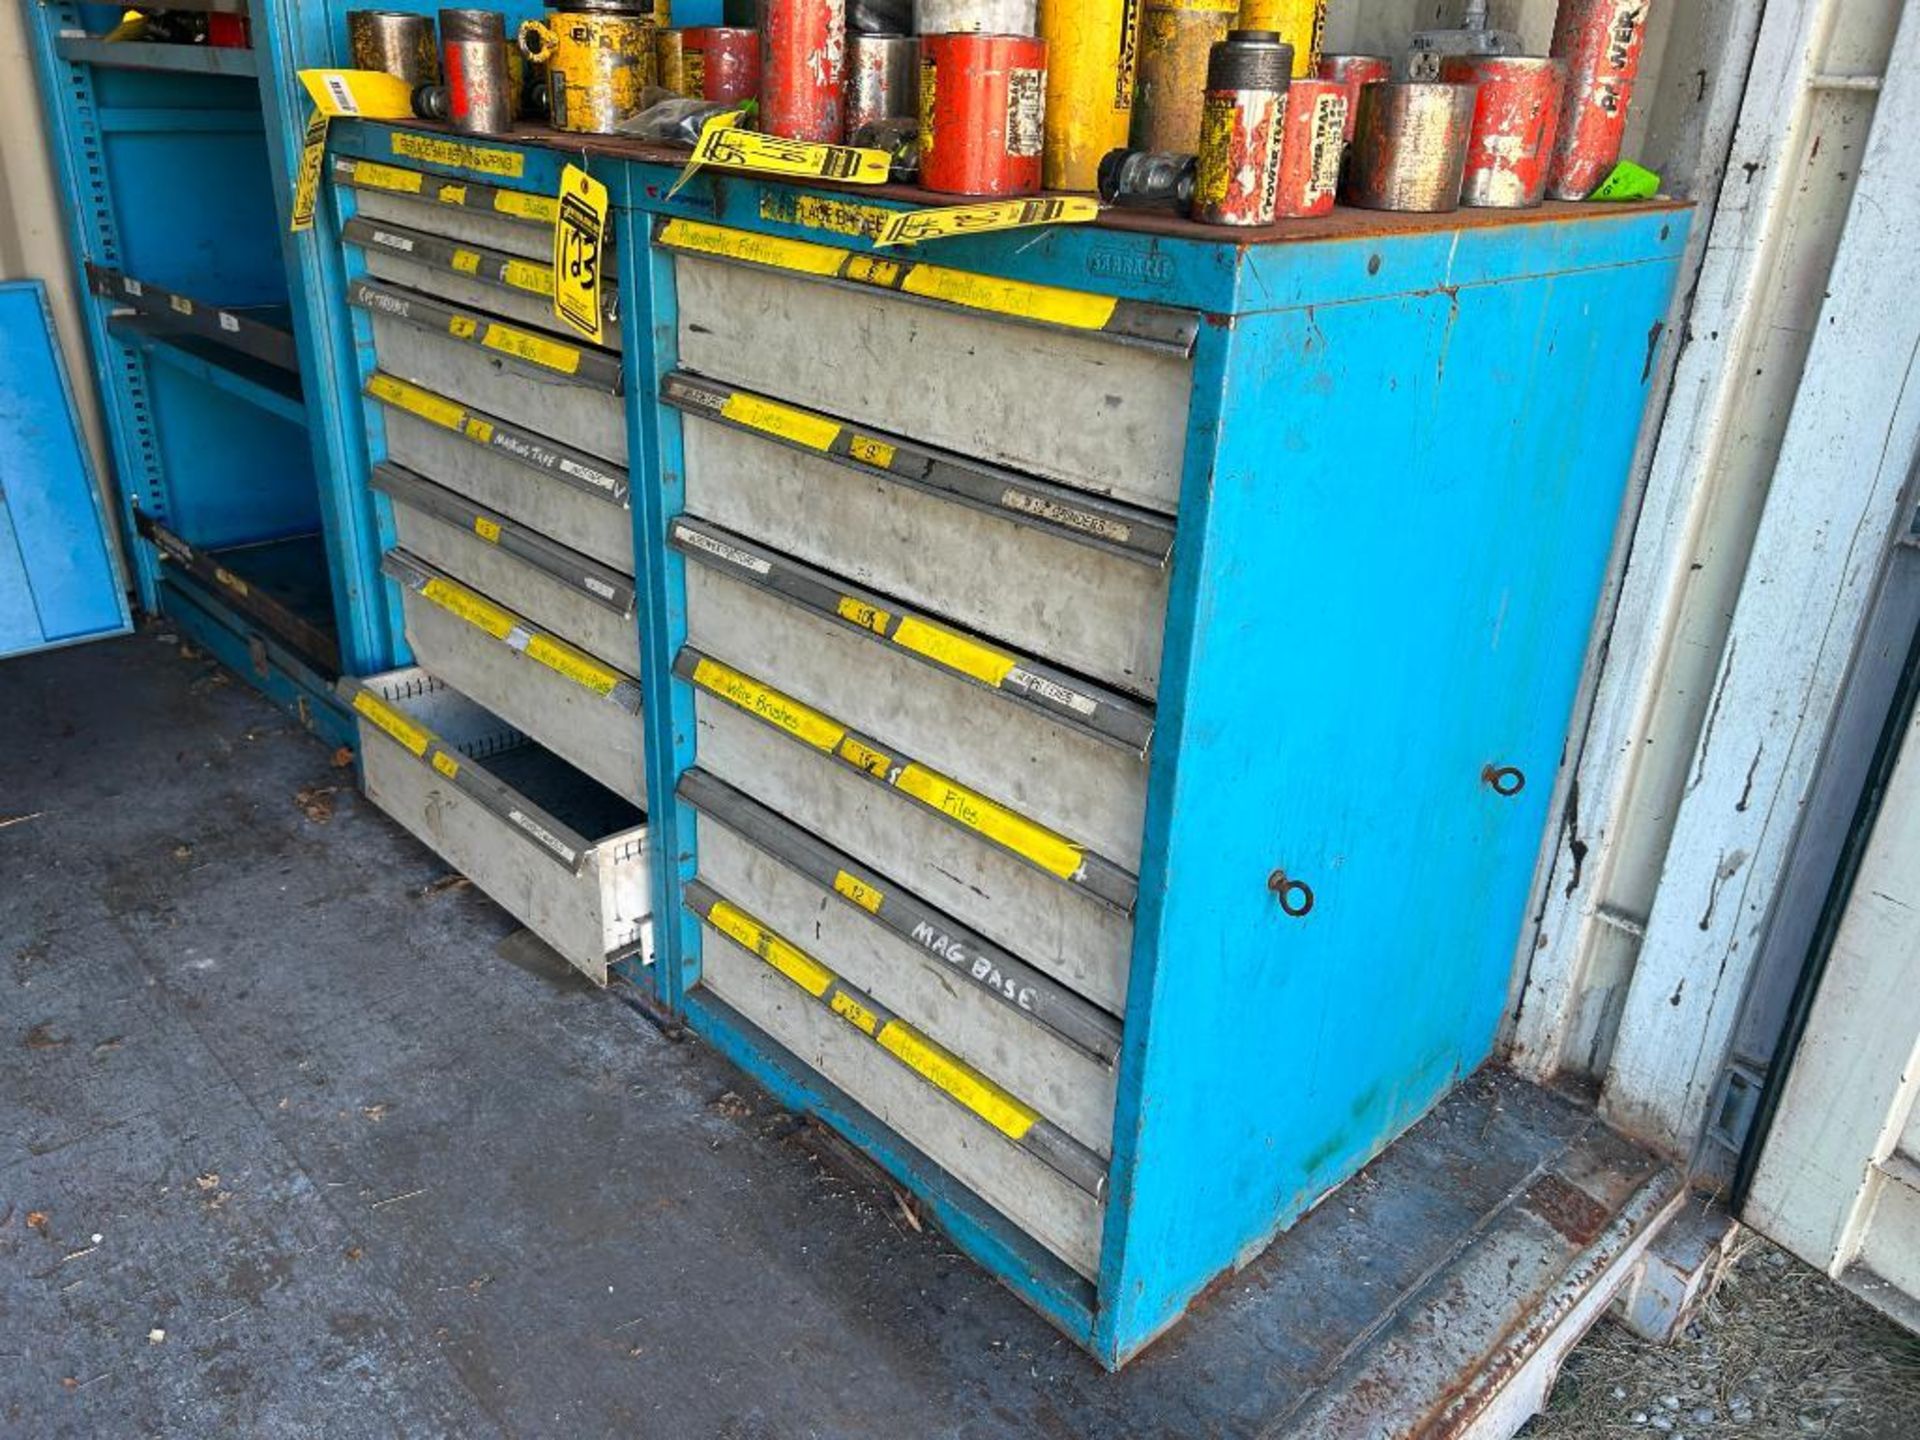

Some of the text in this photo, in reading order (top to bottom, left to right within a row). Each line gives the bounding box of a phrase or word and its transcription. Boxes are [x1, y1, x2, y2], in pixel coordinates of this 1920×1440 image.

[1316, 99, 1330, 139] TEAM
[1265, 99, 1286, 207] POWER TEAM
[727, 681, 798, 730] Wire Brushes
[942, 788, 978, 825] Files
[851, 884, 865, 901] 12
[911, 920, 1038, 1011] MAG BASE
